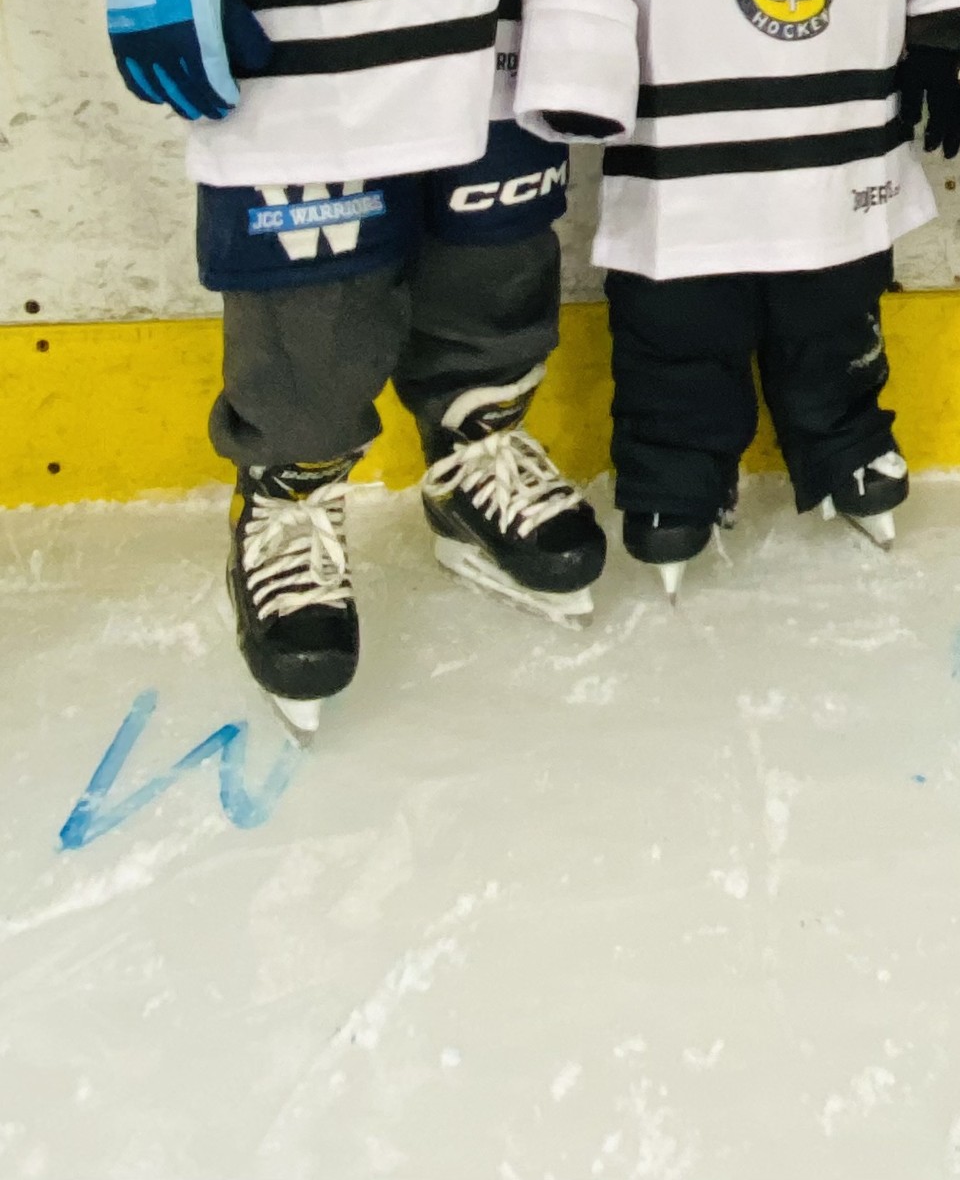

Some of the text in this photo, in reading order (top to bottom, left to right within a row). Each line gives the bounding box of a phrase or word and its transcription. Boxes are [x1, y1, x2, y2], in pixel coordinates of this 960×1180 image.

[752, 8, 829, 39] HOCKEY
[449, 159, 568, 213] CCM
[252, 210, 284, 230] JCC
